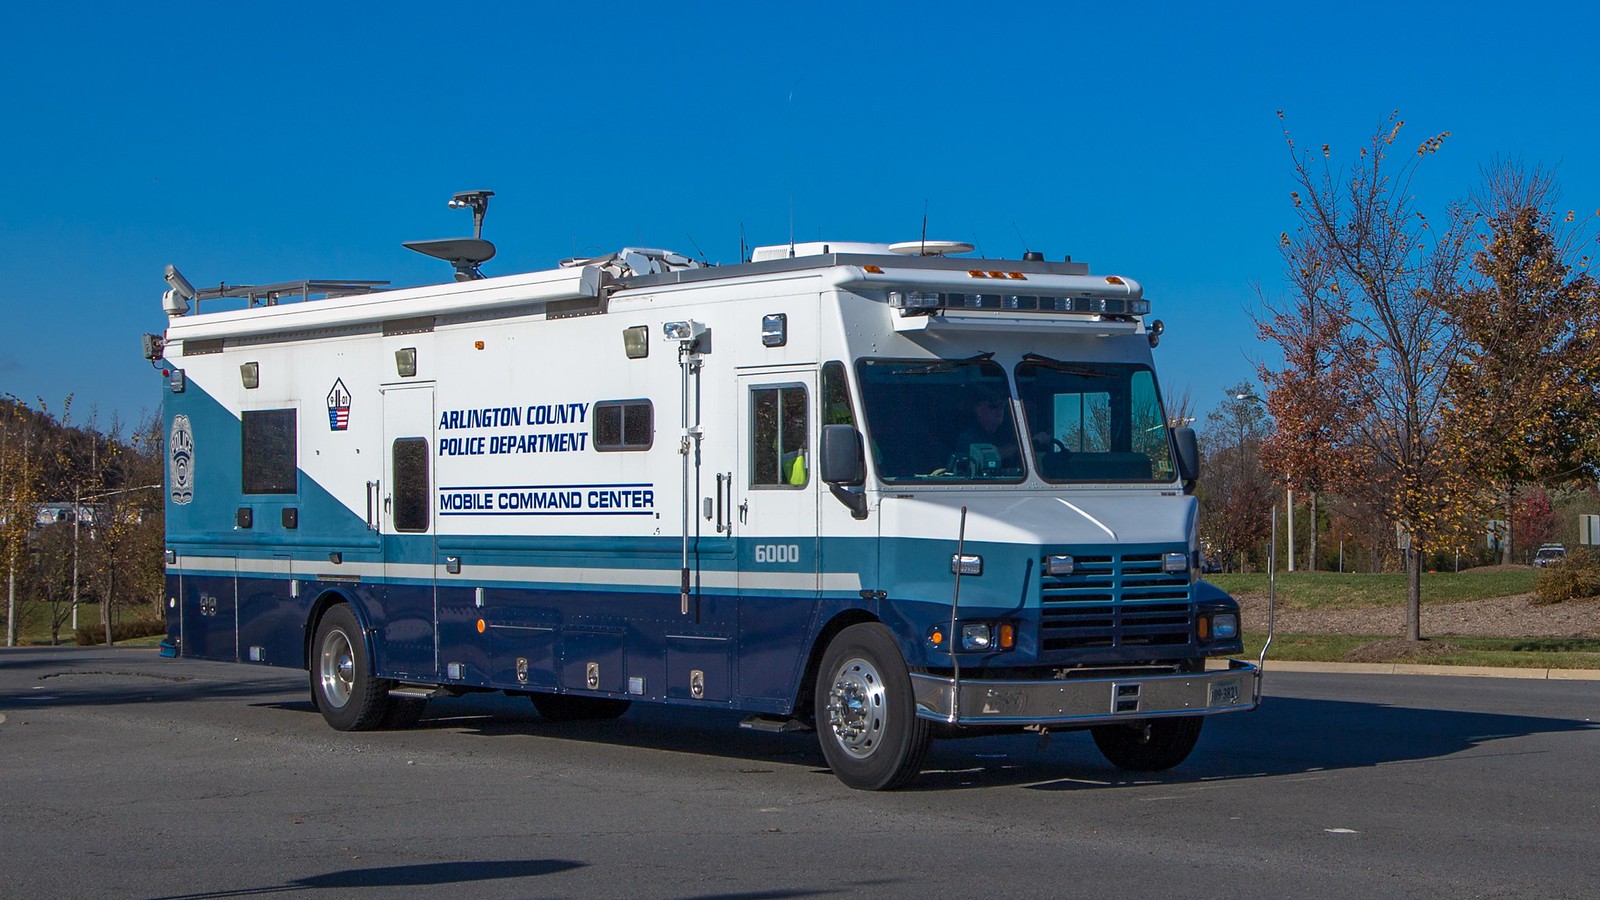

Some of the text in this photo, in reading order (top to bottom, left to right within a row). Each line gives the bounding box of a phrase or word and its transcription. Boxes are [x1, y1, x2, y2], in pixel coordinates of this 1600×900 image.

[438, 403, 589, 430] ARLINGTON COUNTY
[171, 430, 193, 457] POLICE
[439, 432, 588, 456] POLICE DEPARTMENT
[440, 490, 654, 510] MOBILE COMMAND CENTER
[755, 544, 799, 563] 6000
